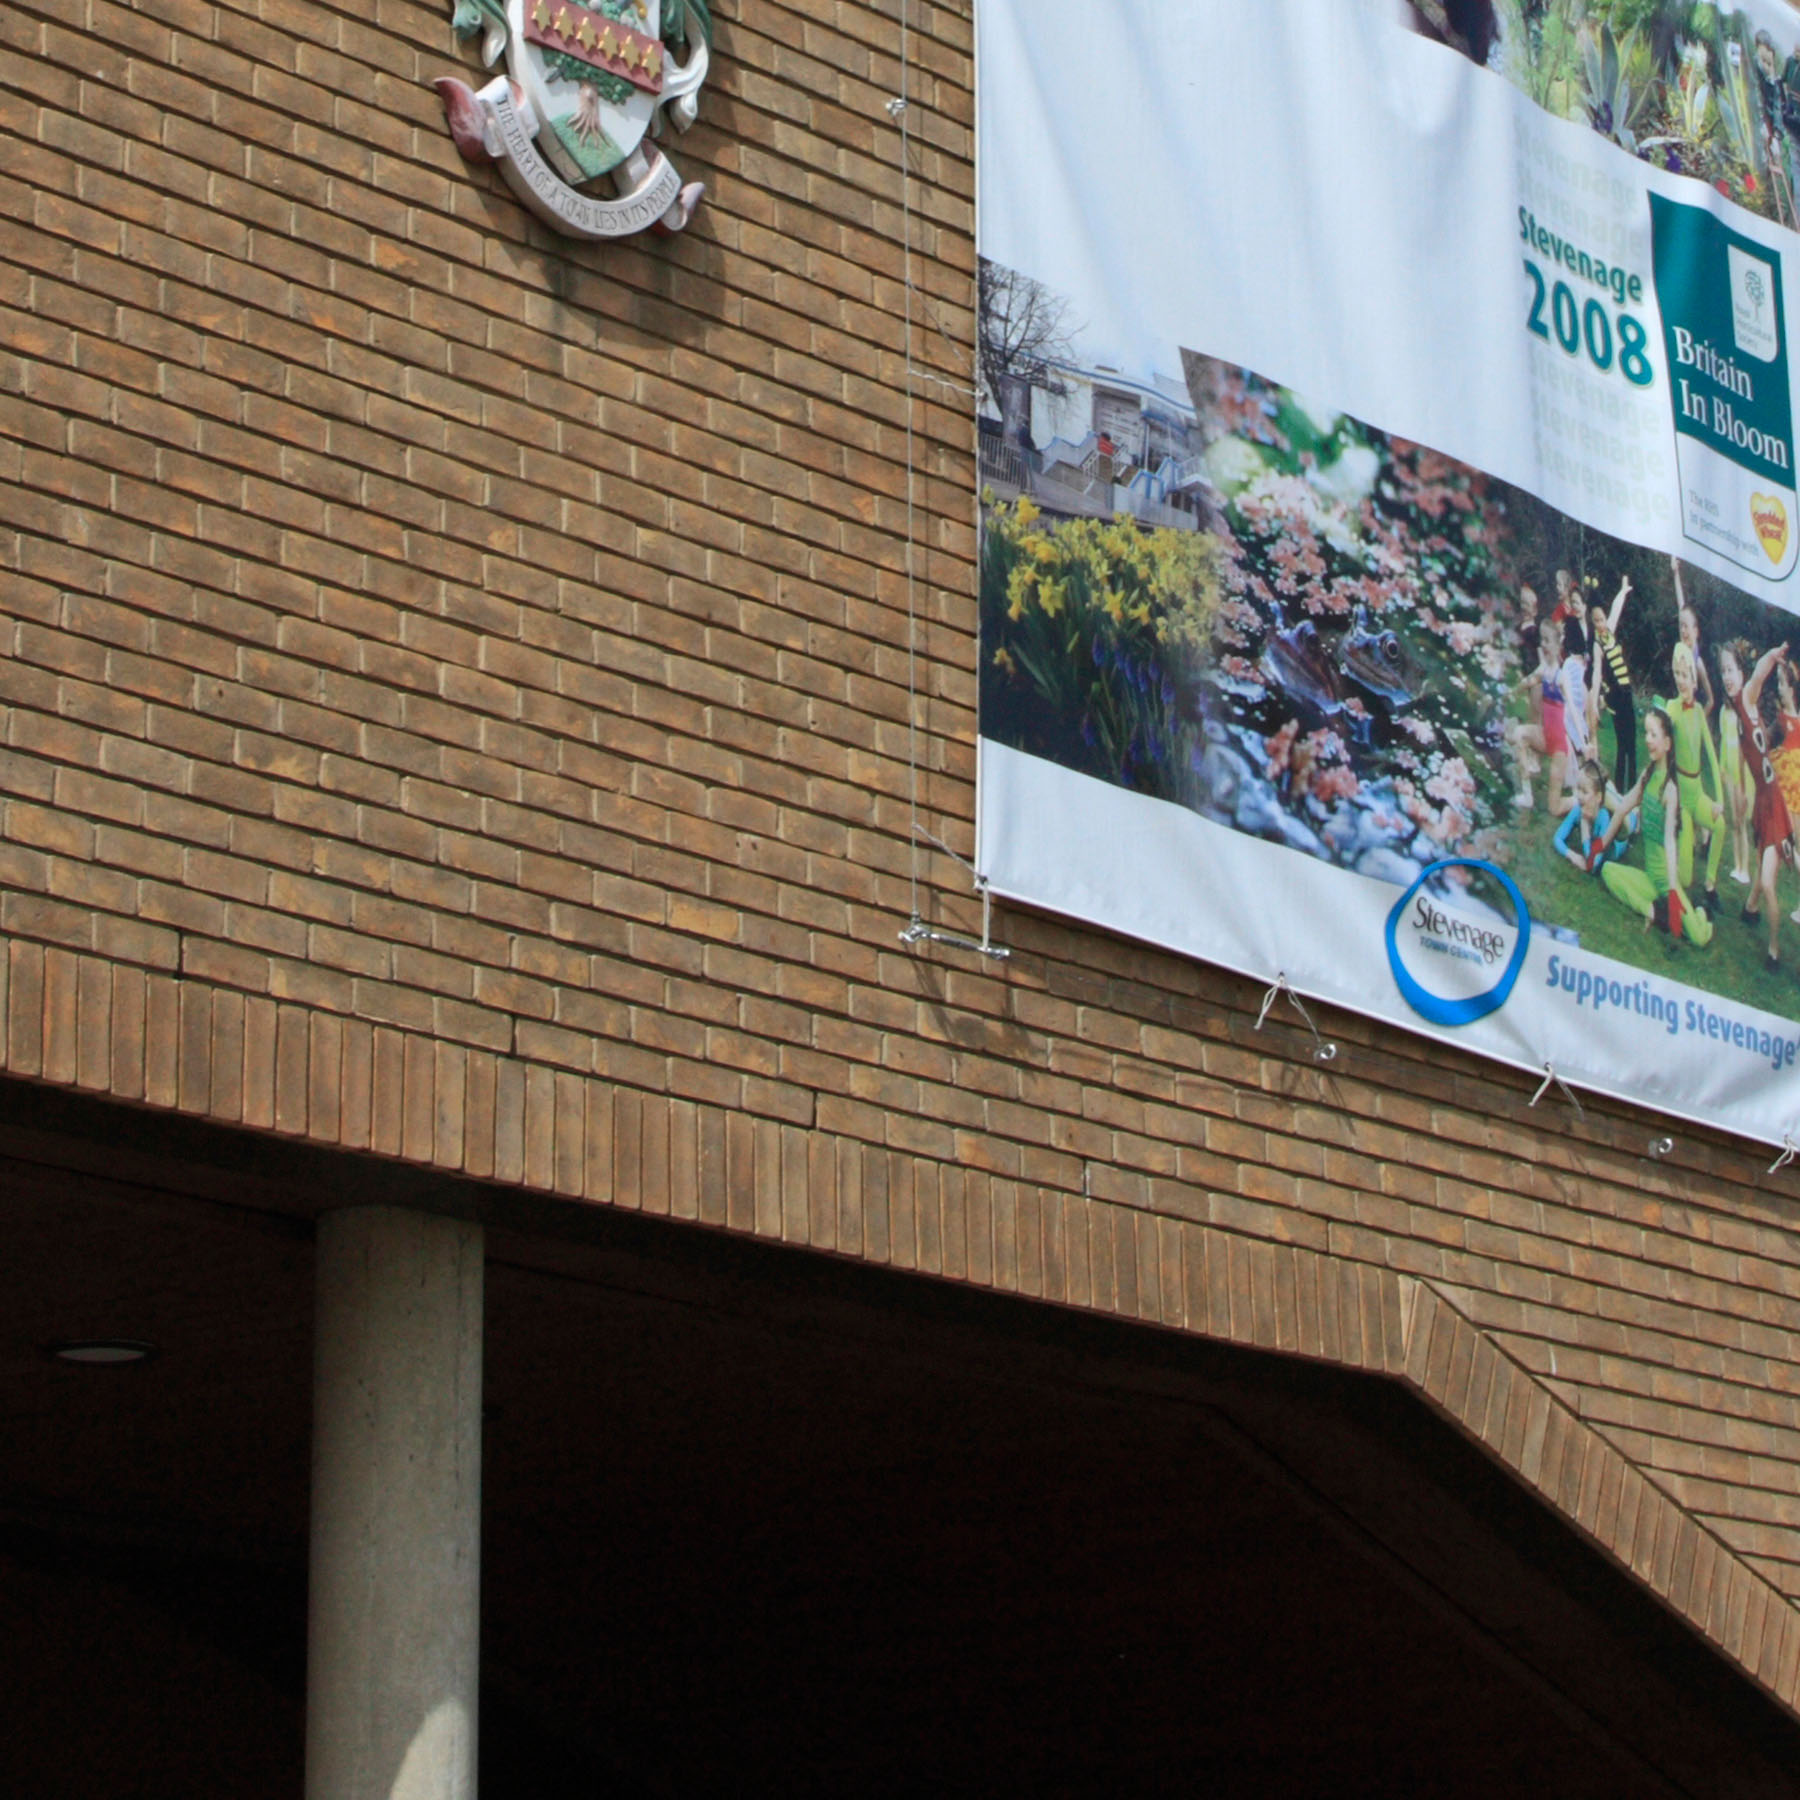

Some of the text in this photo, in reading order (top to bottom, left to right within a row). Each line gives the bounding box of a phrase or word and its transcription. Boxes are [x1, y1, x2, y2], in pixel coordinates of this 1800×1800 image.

[1518, 205, 1642, 306] Stevenage
[1522, 258, 1654, 387] 2008
[1671, 325, 1755, 403] Britain
[1678, 378, 1790, 470] In Bloom
[1412, 895, 1504, 965] Stevenage
[1545, 954, 1679, 1034] Supporting
